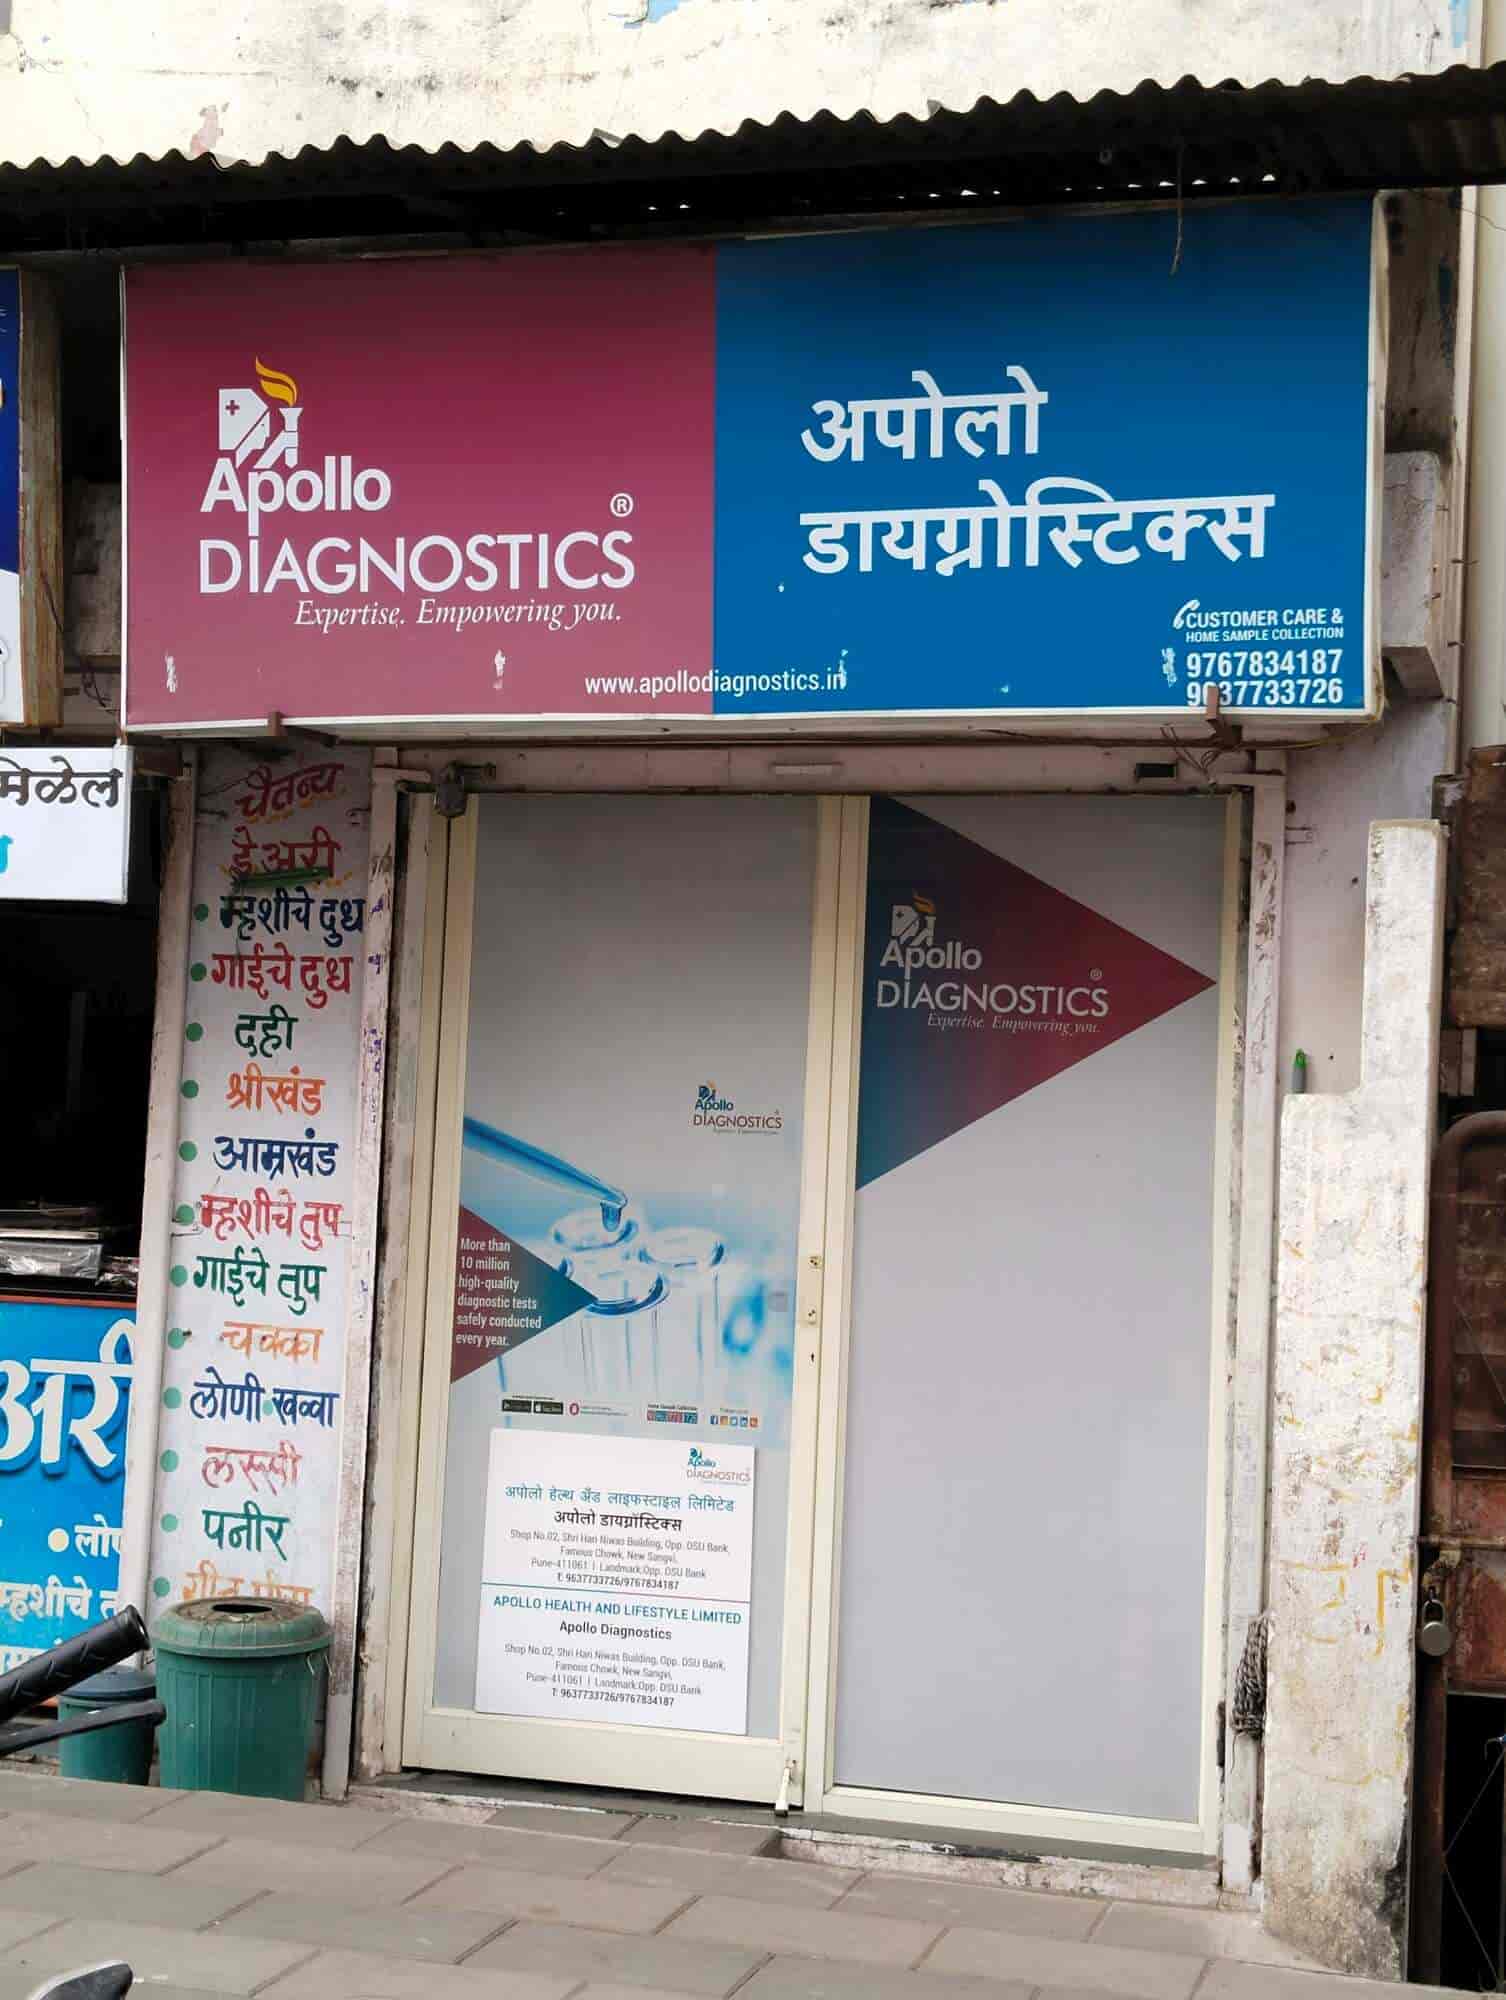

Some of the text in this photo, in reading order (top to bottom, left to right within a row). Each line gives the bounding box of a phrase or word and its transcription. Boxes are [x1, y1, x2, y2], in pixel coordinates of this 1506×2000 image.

[801, 366, 1048, 462] अपोलो
[200, 455, 392, 537] Apollo
[200, 530, 635, 594] DIAGNOSTICS
[294, 599, 622, 634] Expertise. Empowering you.
[1186, 608, 1344, 629] CUSTOMER CARE &
[1186, 627, 1344, 643] HOME SAMPLE COLLECTION
[1186, 648, 1344, 678] 9767834187
[585, 668, 846, 698] www.apollodiagnostics.in
[211, 943, 295, 1000] गाईचे
[880, 938, 983, 980] Apollo
[876, 979, 1110, 1018] DIAGNOSTICS
[234, 1004, 299, 1058] दही
[225, 1062, 326, 1116] श्रीखंड
[693, 1114, 783, 1129] DIAGNOSTICS
[694, 1098, 735, 1116] Apollo
[212, 1127, 340, 1182] आम्रखंड
[460, 1237, 511, 1252] More than
[193, 1245, 271, 1307] गाईचे
[461, 1256, 511, 1270] 10 million
[458, 1273, 520, 1293] high-quality
[457, 1293, 538, 1311] diagnostic tests
[456, 1312, 543, 1329] safely conducted
[455, 1333, 511, 1348] every year.
[190, 1366, 266, 1423] लोणी
[504, 1483, 543, 1500] अपोलो
[202, 1500, 290, 1561] पनीर
[554, 1507, 596, 1525] अपोलो
[626, 1551, 646, 1561] New
[493, 1595, 742, 1625] APOLLO HEALTH AND LIFESTYLE LIMITED
[559, 1620, 672, 1641] Apollo Diagnostics
[622, 1665, 641, 1675] New
